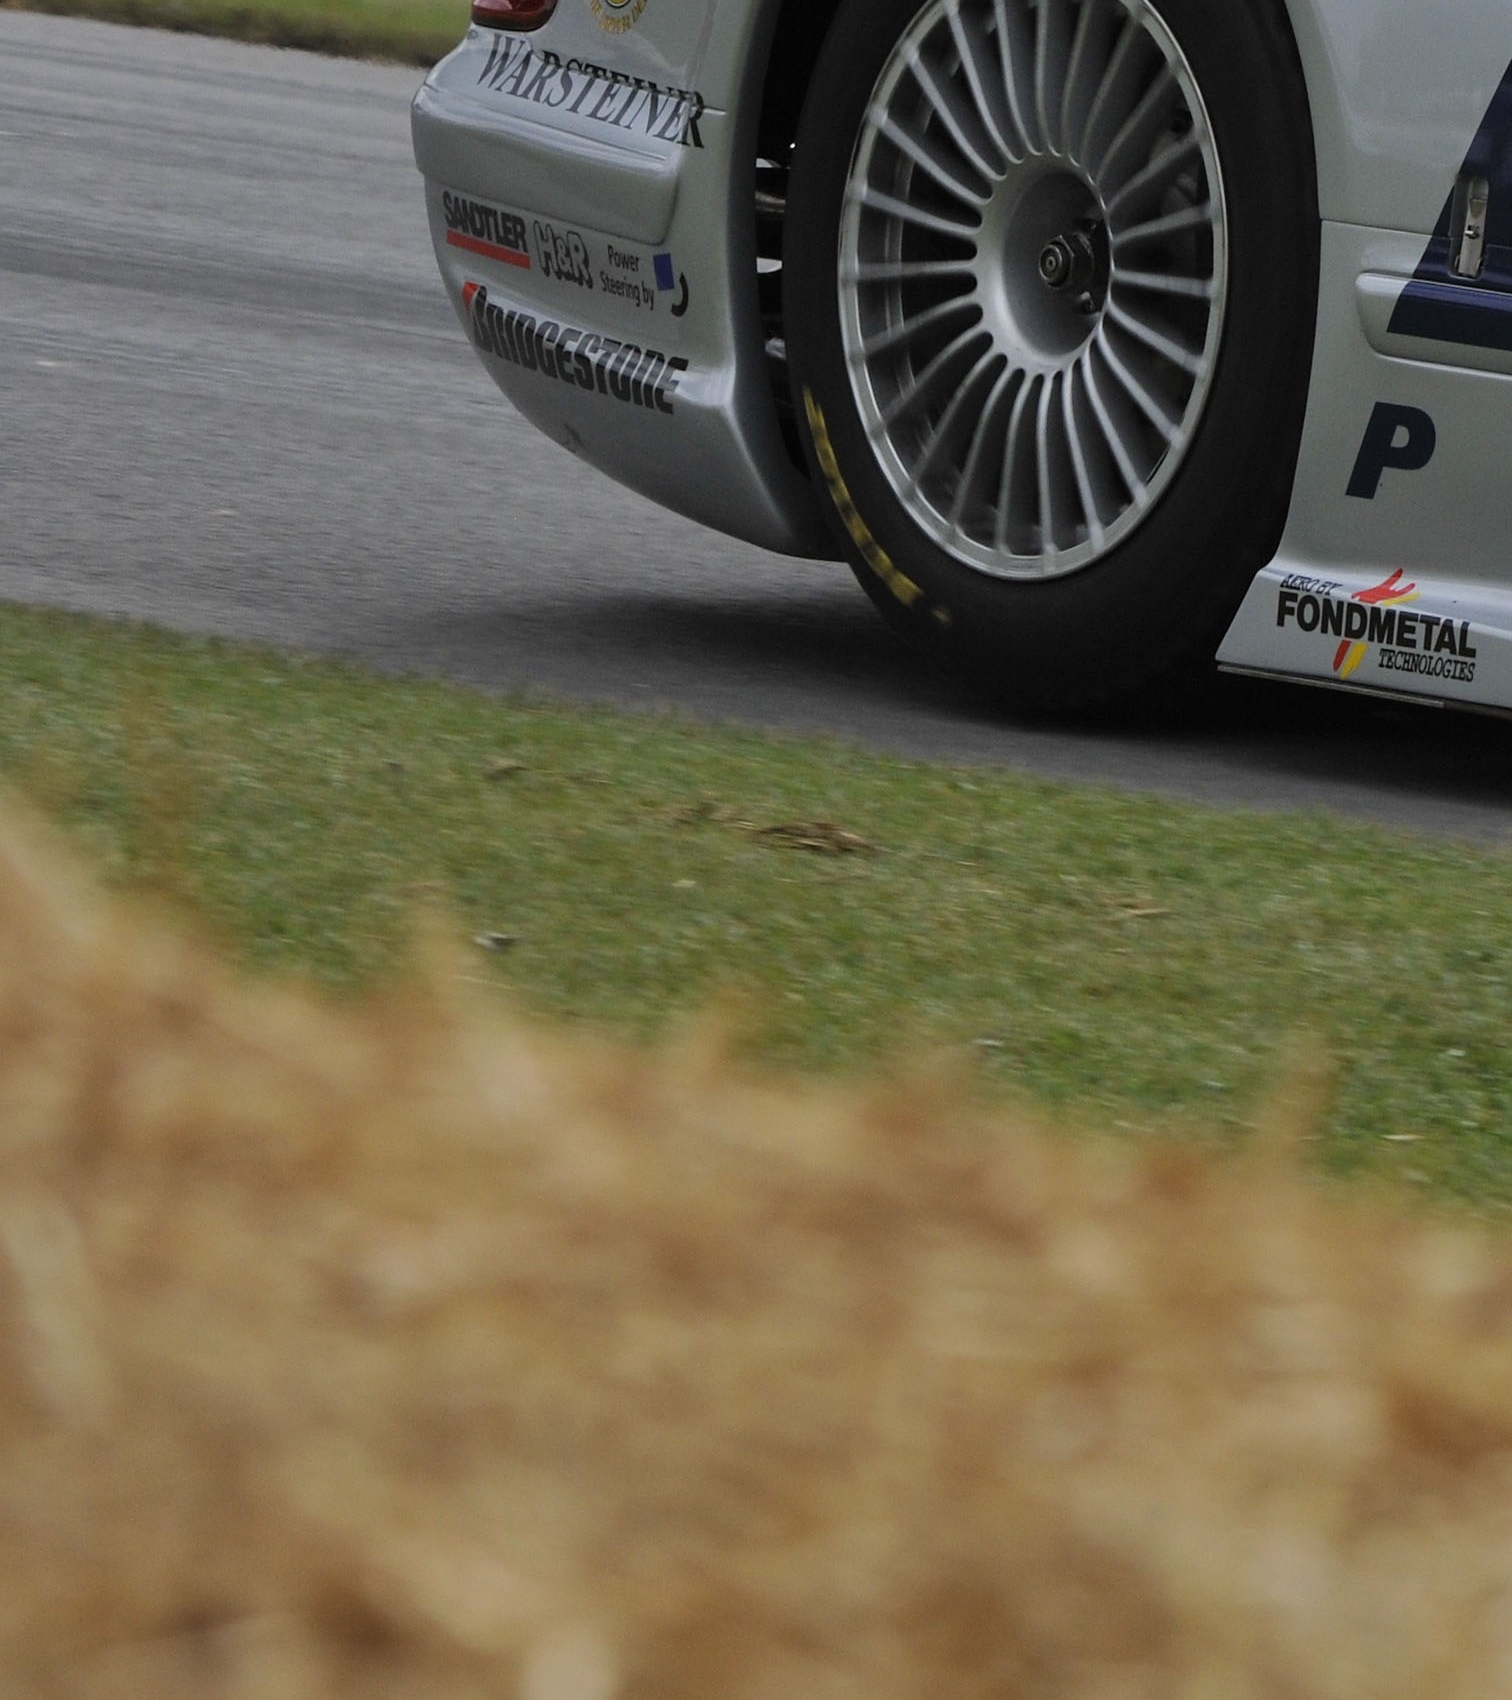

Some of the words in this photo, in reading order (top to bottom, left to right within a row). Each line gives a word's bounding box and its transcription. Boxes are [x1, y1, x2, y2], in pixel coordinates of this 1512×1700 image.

[476, 33, 705, 148] WARSTEINER
[442, 190, 529, 253] SANDTLER
[533, 219, 594, 290] H&R
[608, 244, 640, 273] Power
[599, 270, 641, 307] Steering
[641, 284, 655, 311] by
[462, 281, 690, 415] BRIDGESTONE
[1280, 573, 1315, 592] AERO
[1316, 580, 1343, 595] BY
[1276, 591, 1477, 659] FONDMETAL
[1378, 648, 1476, 683] TECHNOLOGIES
